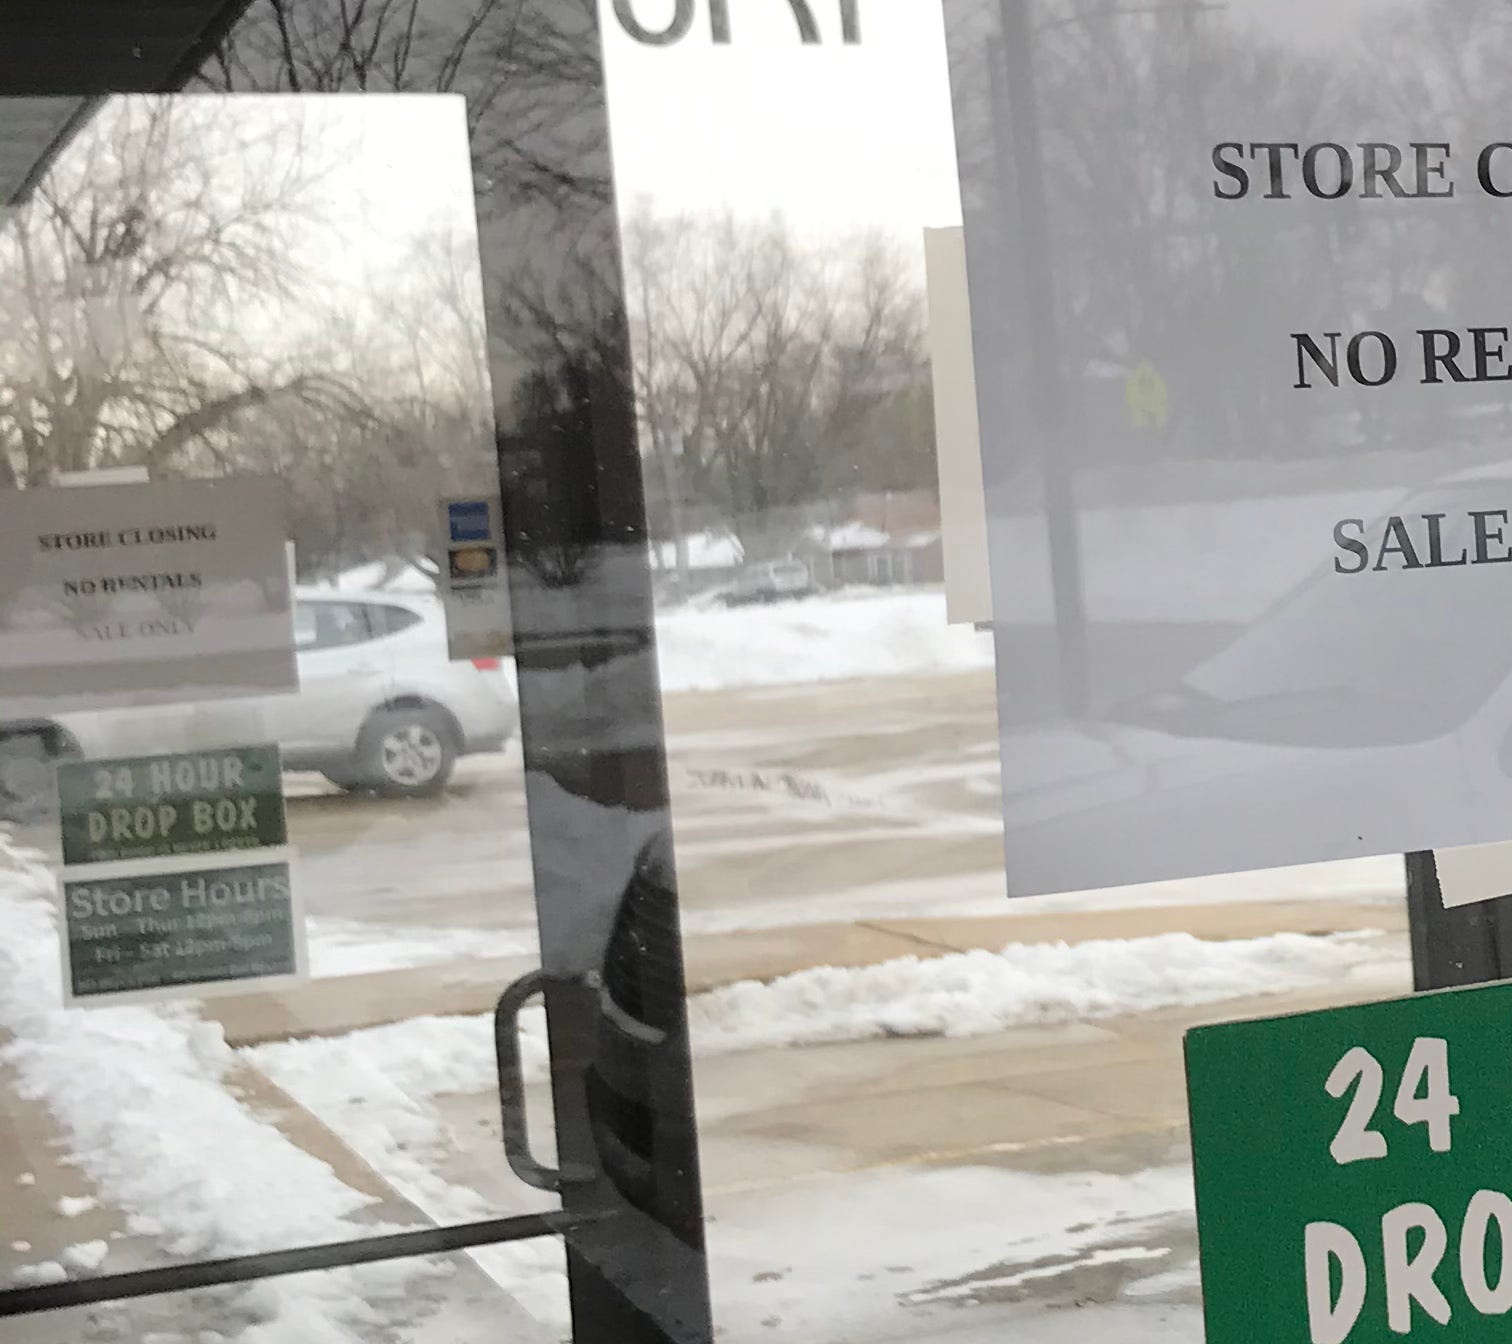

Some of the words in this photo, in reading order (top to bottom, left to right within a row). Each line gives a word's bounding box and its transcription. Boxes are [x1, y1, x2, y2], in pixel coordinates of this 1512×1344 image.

[1211, 142, 1455, 200] STORE
[1290, 331, 1398, 389] NO
[38, 531, 111, 552] STORE
[118, 524, 216, 546] CLOSING
[63, 579, 96, 596] NO
[100, 572, 202, 593] RENTALS
[150, 756, 244, 795] HOUR
[88, 805, 177, 842] DROP
[193, 796, 257, 834] BOX
[71, 887, 171, 920] Store
[180, 876, 288, 908] Hours
[1324, 1036, 1461, 1165] 24
